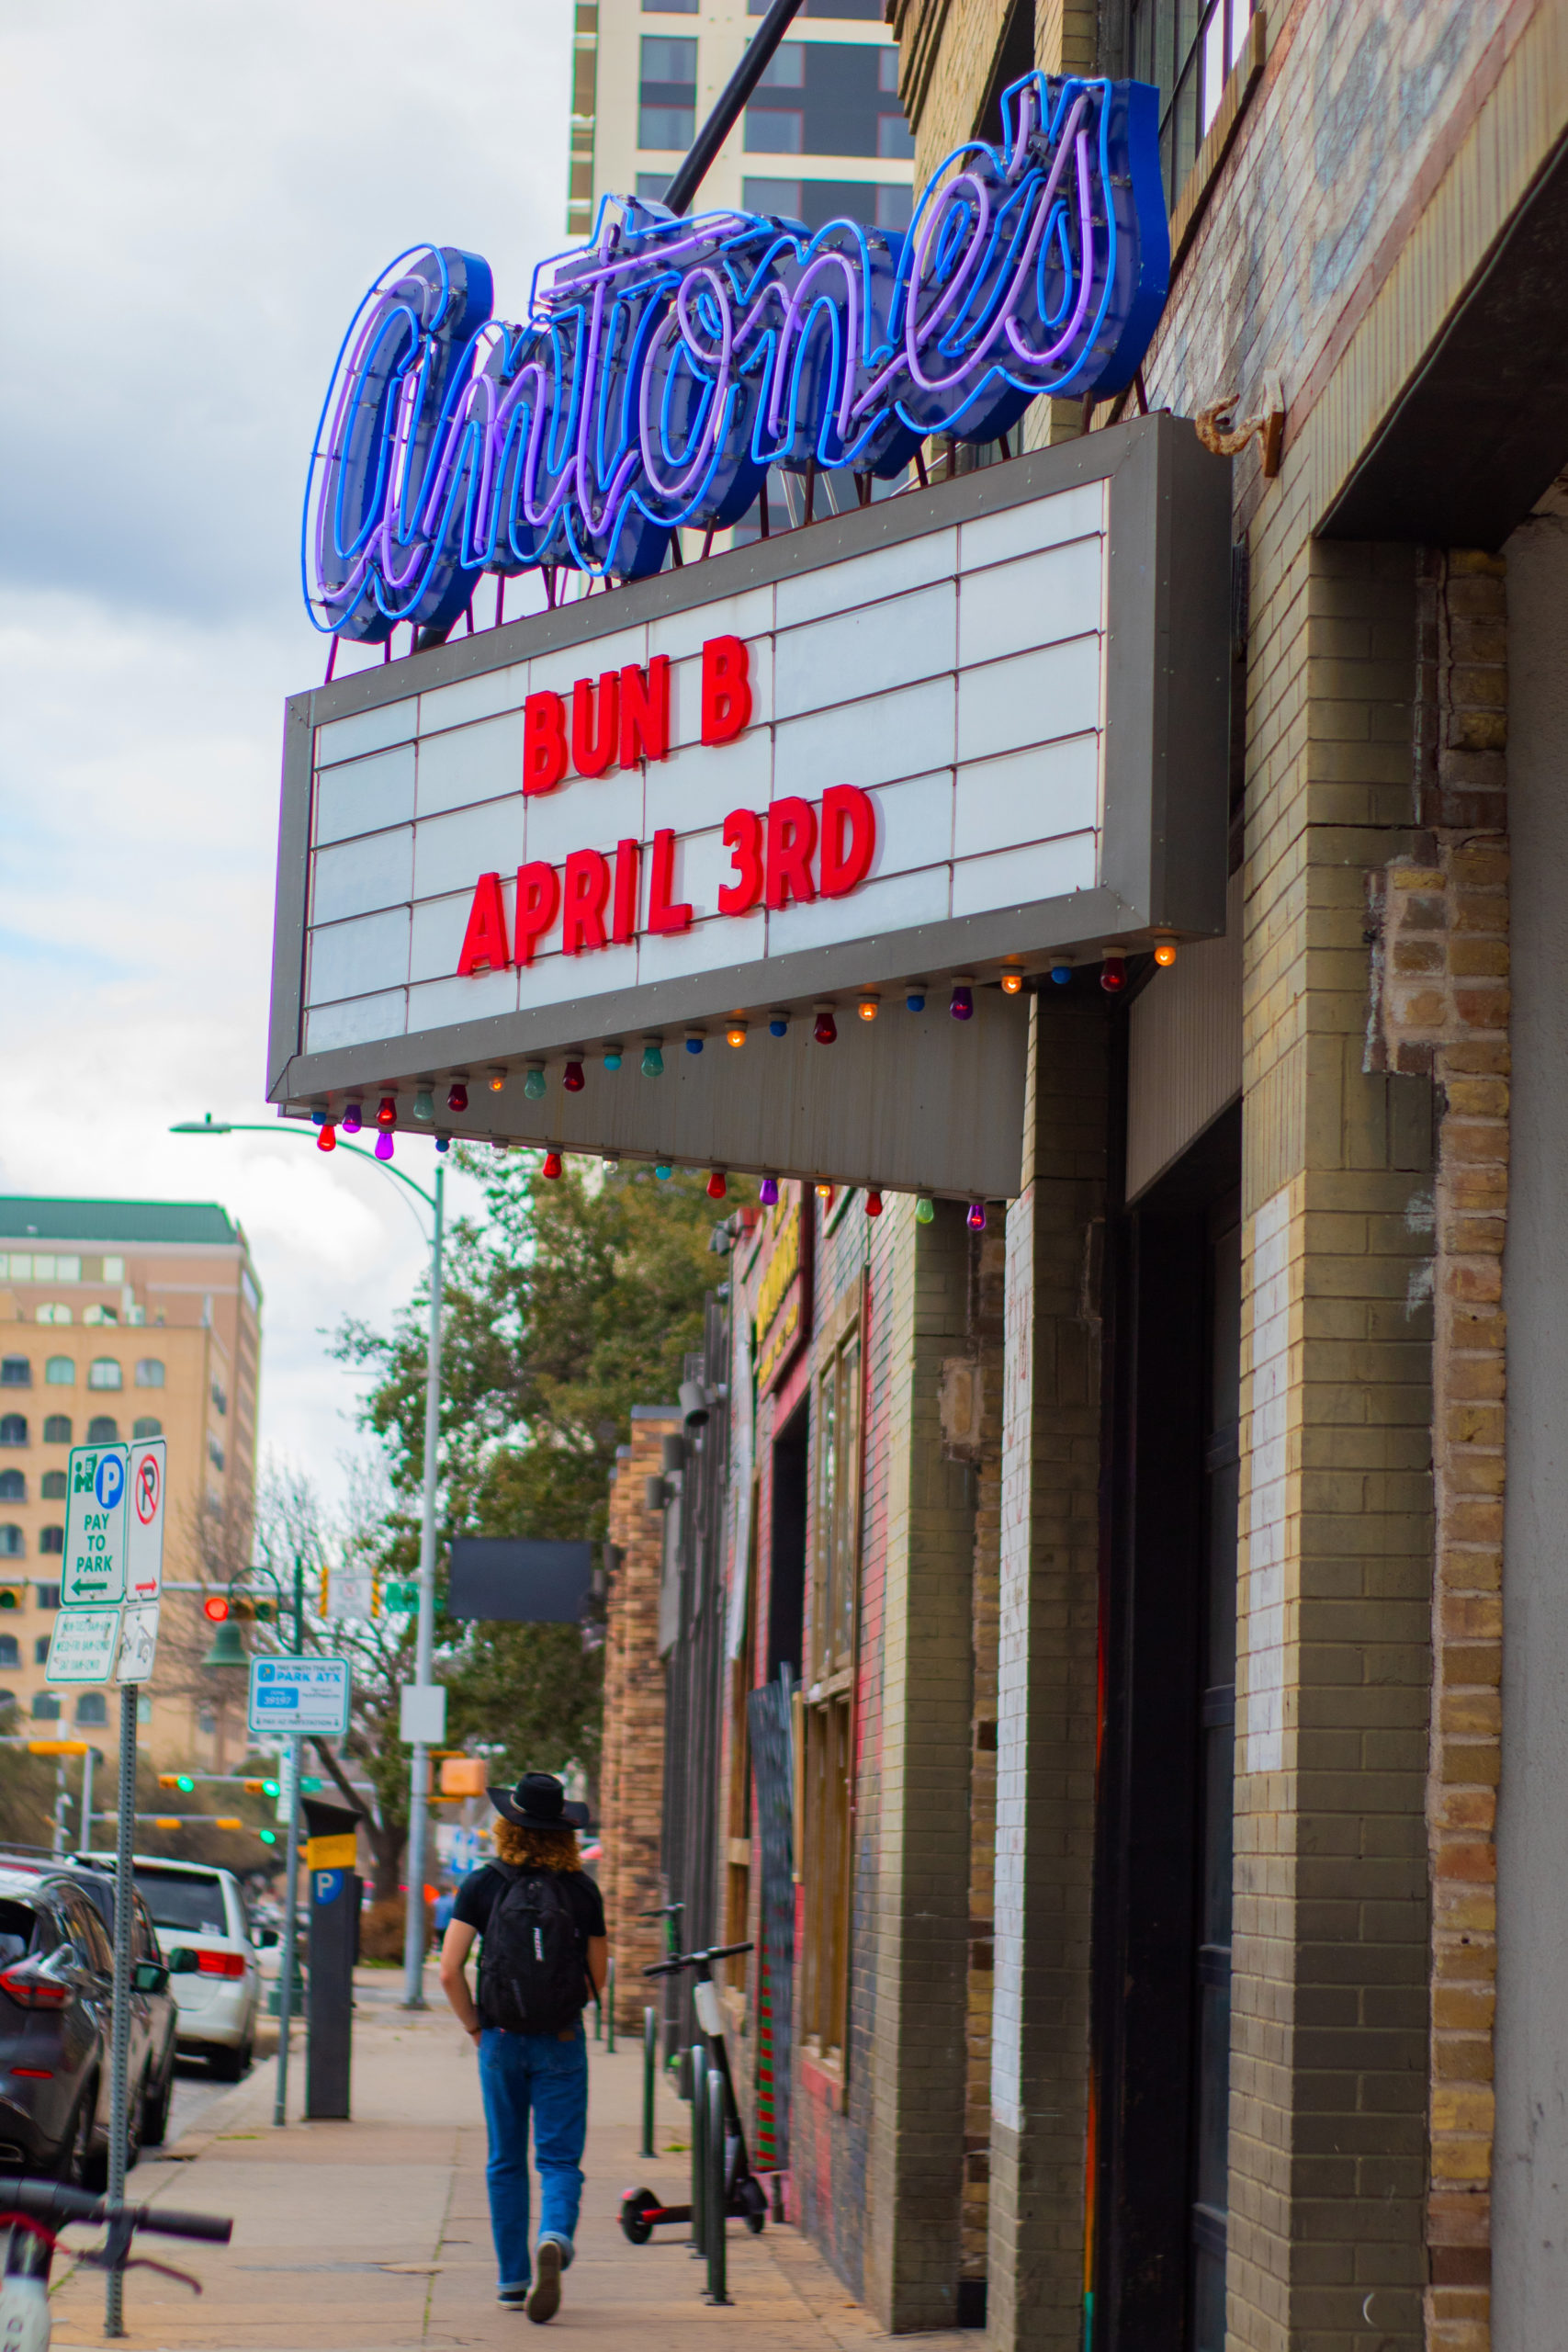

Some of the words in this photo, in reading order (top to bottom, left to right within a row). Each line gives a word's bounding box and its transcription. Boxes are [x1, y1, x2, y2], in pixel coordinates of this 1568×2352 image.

[516, 653, 672, 797] BUN
[696, 634, 755, 748] B
[455, 827, 695, 978] APRIL
[716, 783, 877, 919] 3RD
[84, 1513, 109, 1531] PAY
[87, 1534, 106, 1552] TO
[76, 1555, 113, 1573] PARK
[276, 1671, 310, 1682] PARK
[315, 1672, 341, 1683] ATX
